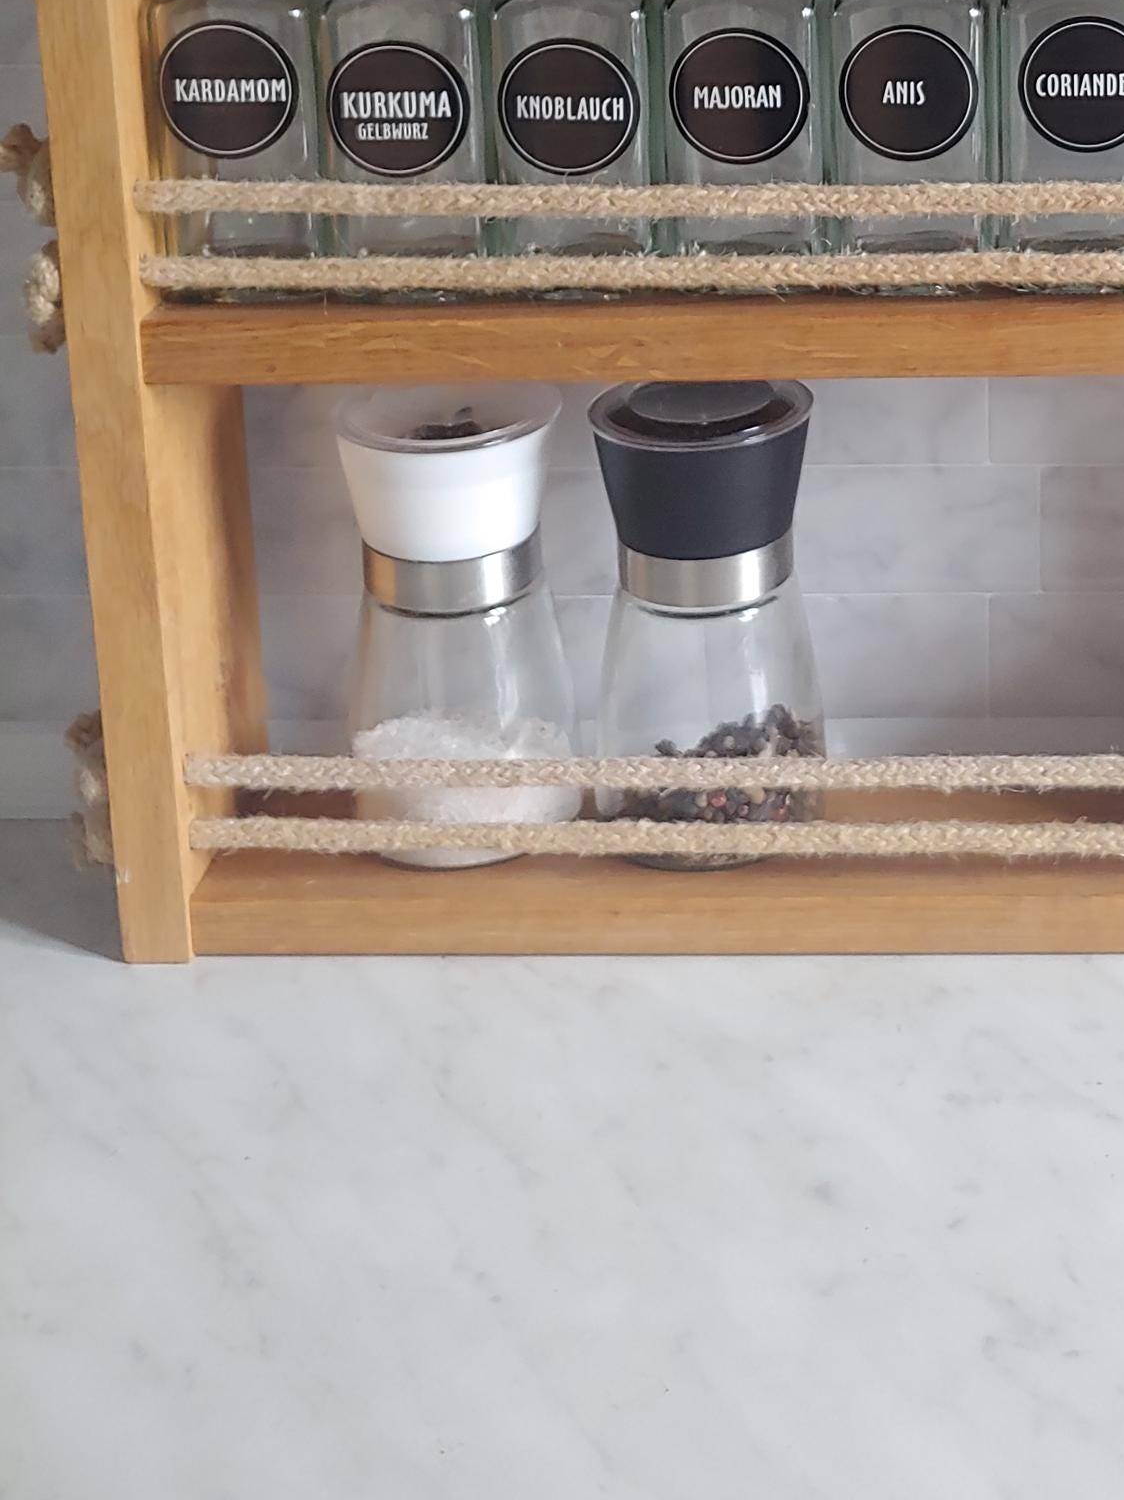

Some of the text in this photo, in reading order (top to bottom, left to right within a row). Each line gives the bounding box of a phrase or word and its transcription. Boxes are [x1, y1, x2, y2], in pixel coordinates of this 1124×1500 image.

[175, 78, 287, 103] KARDAMOM
[693, 84, 782, 110] MAJORAN
[882, 80, 925, 105] ANIS
[341, 90, 452, 120] KURKUMA
[516, 95, 624, 122] KNOBLAUCH
[357, 121, 429, 141] GELBWURZ
